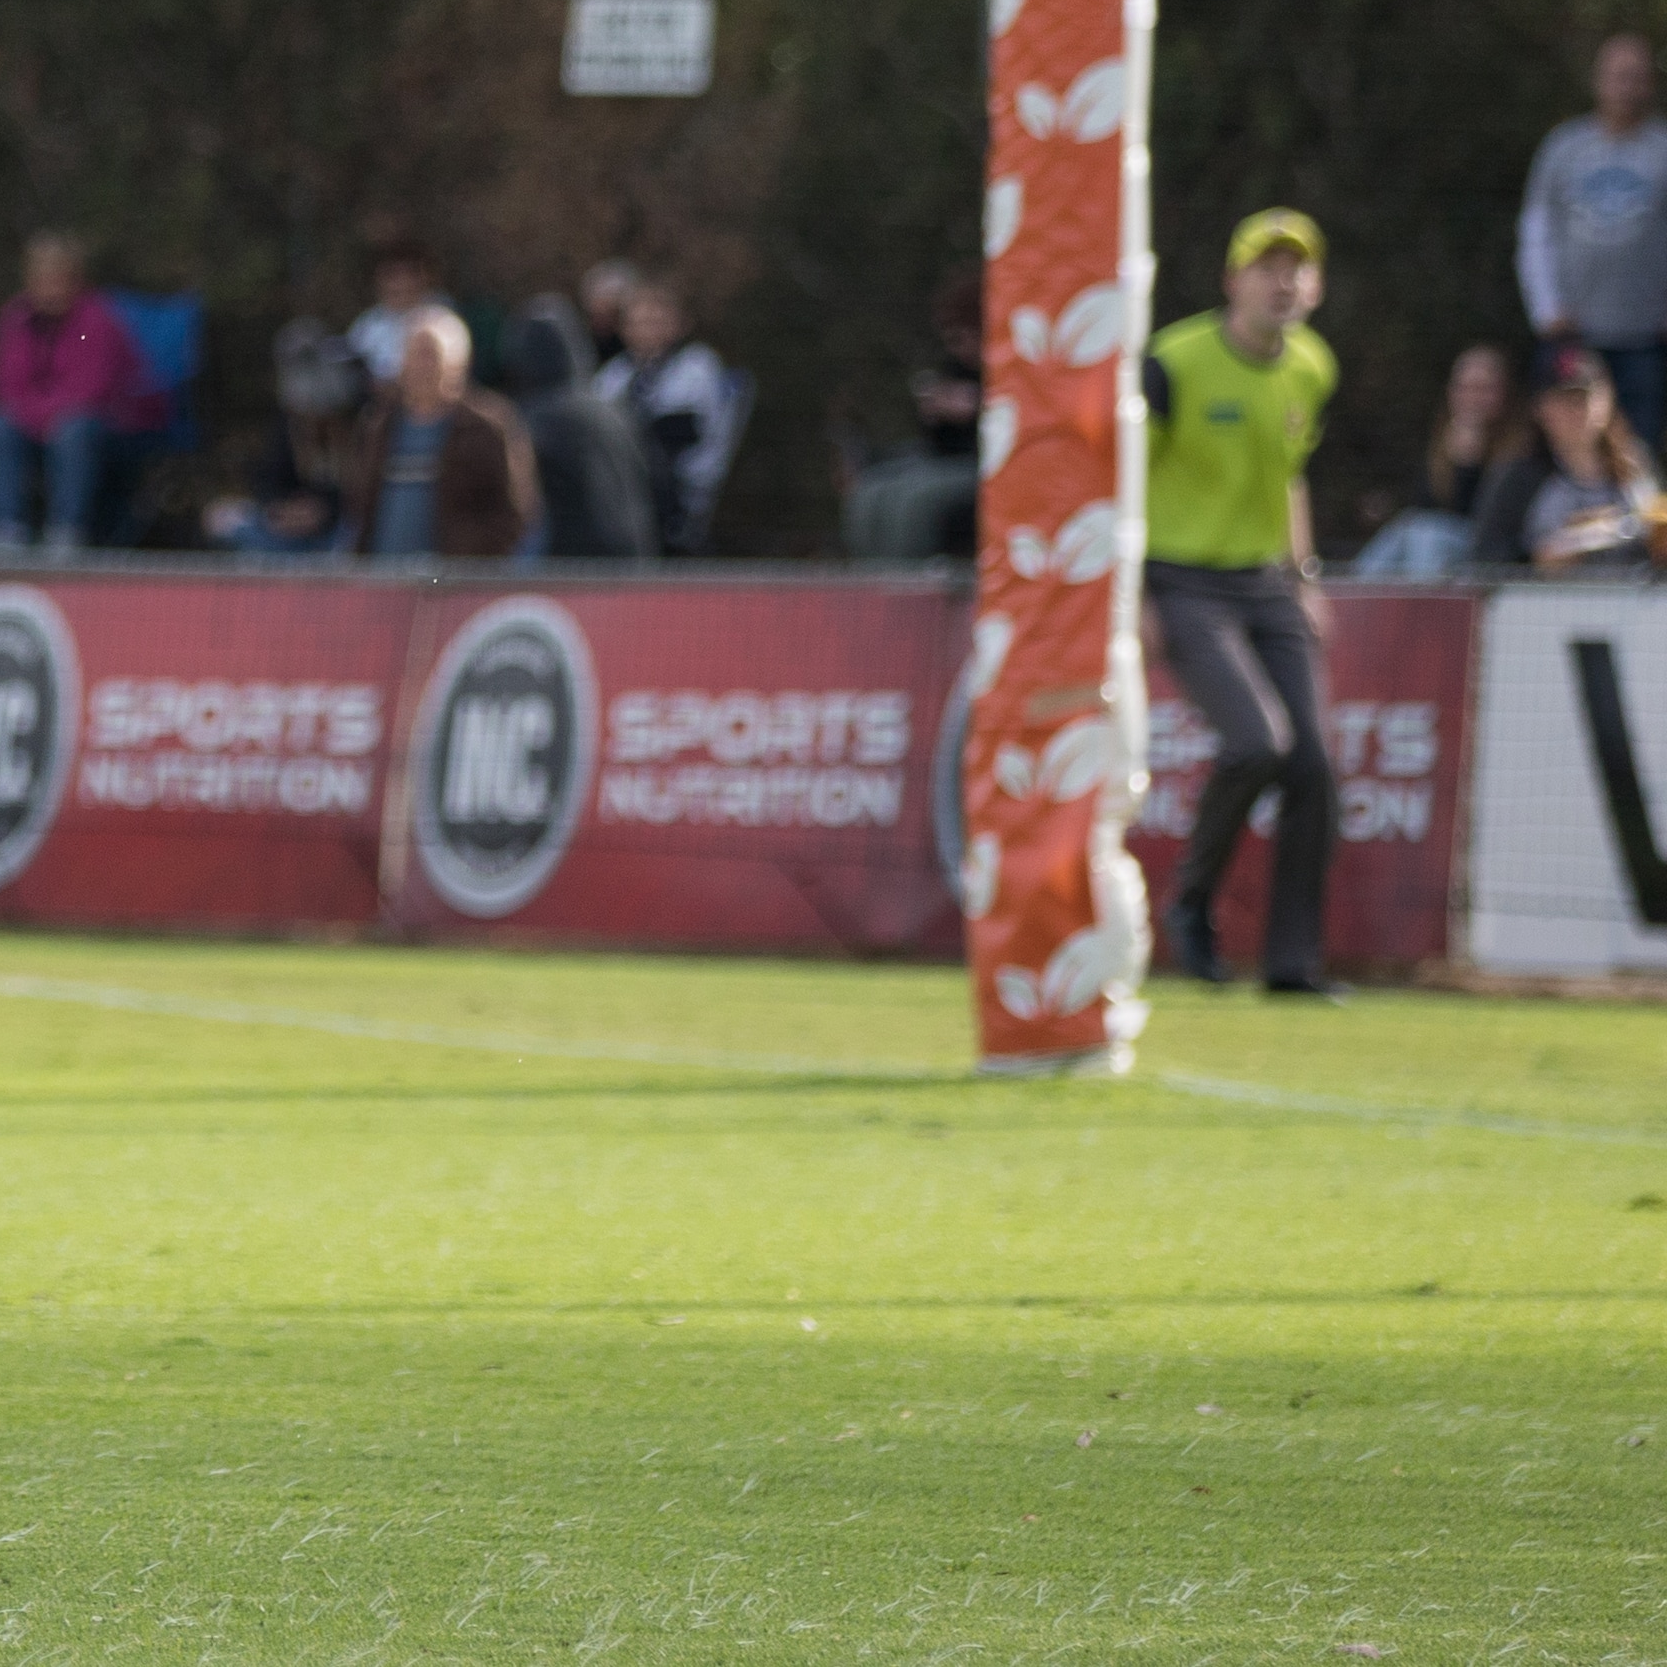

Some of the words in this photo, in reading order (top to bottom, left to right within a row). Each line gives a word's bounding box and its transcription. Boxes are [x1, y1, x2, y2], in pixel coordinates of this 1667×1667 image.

[89, 677, 381, 754] SPORTS
[609, 688, 911, 765] SPORTS
[80, 753, 371, 816] NUTRITION
[598, 764, 904, 827] NUTRITION
